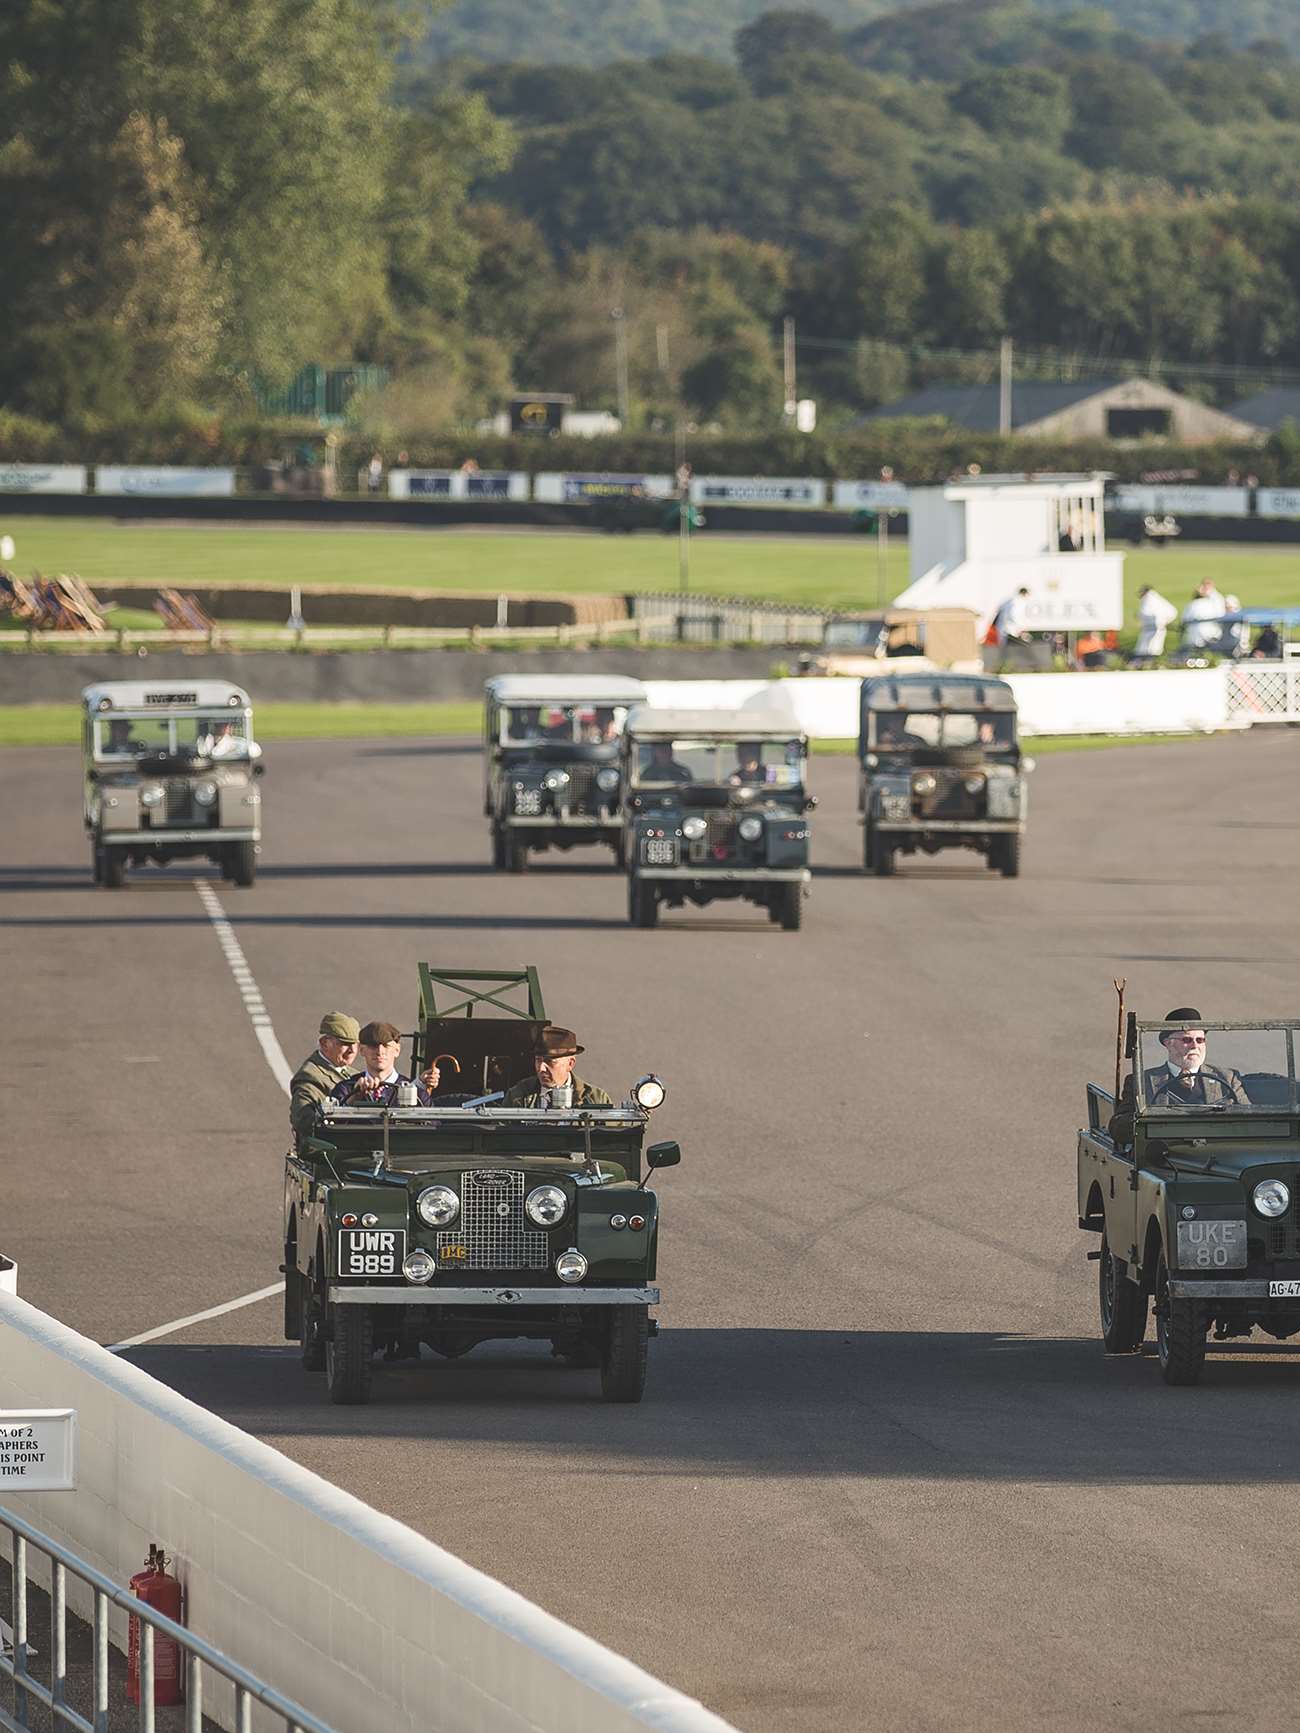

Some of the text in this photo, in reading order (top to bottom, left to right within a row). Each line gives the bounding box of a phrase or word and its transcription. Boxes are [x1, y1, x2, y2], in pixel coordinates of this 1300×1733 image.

[350, 1232, 395, 1251] UWR
[1188, 1223, 1236, 1243] UKE
[350, 1255, 395, 1273] 989
[1197, 1247, 1227, 1266] 80
[11, 1428, 24, 1437] OF
[27, 1428, 33, 1437] 2
[14, 1453, 45, 1462] POINT
[1, 1466, 26, 1475] TIME
